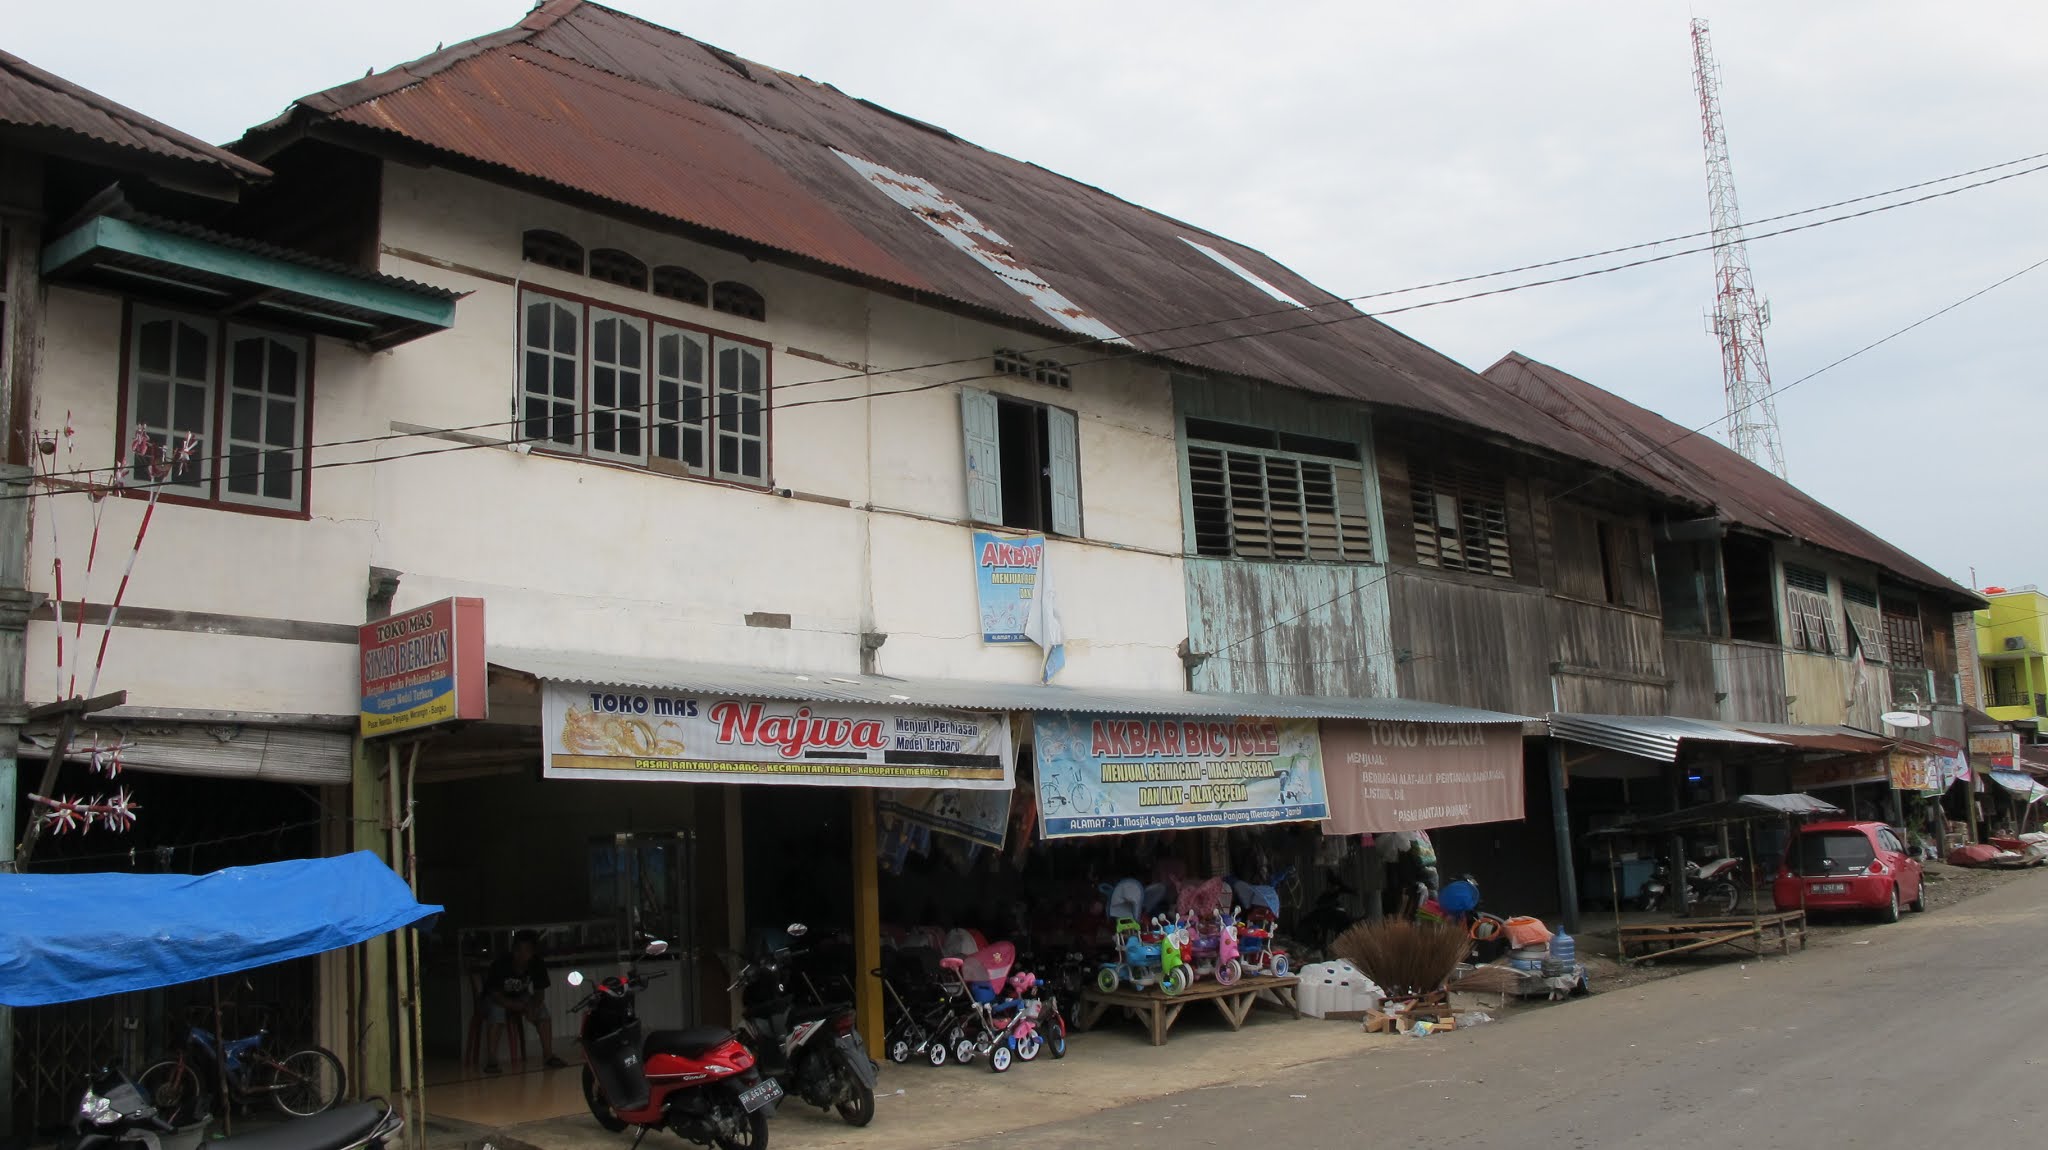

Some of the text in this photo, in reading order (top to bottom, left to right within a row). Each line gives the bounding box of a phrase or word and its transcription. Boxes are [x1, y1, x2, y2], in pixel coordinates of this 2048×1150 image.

[377, 611, 434, 643] TOKO MAS
[590, 693, 699, 717] TOKO MAS
[709, 702, 889, 758] Najwa
[895, 717, 979, 736] Menjual Perhiasan
[1091, 720, 1280, 757] AKBAR BICYCLE
[1367, 720, 1418, 748] TOKO
[896, 736, 961, 752] Model Terbaru
[635, 759, 670, 770] PASAR
[672, 761, 711, 771] RANTAU
[713, 762, 759, 772] PANJANG
[766, 763, 824, 774] KECAMATAN
[825, 765, 851, 774] TABIR
[859, 766, 904, 775] KABUPATEN
[1101, 763, 1147, 783] MENJUAL
[1147, 761, 1201, 781] BERMACAM
[1206, 761, 1241, 779] MACAM
[1241, 760, 1275, 779] SEPEDA
[1139, 786, 1160, 807] DAN
[1160, 785, 1183, 806] ALAT
[1190, 784, 1213, 804] ALAT
[1213, 783, 1248, 803] SEPEDA
[1070, 819, 1107, 829] ALAMAT
[1123, 816, 1149, 828] Masjid
[1150, 815, 1175, 827] Agung
[1176, 814, 1196, 825] Pasar
[1197, 812, 1222, 822] Rantau
[1223, 811, 1250, 822] Panjang
[1250, 809, 1279, 819] Merangin
